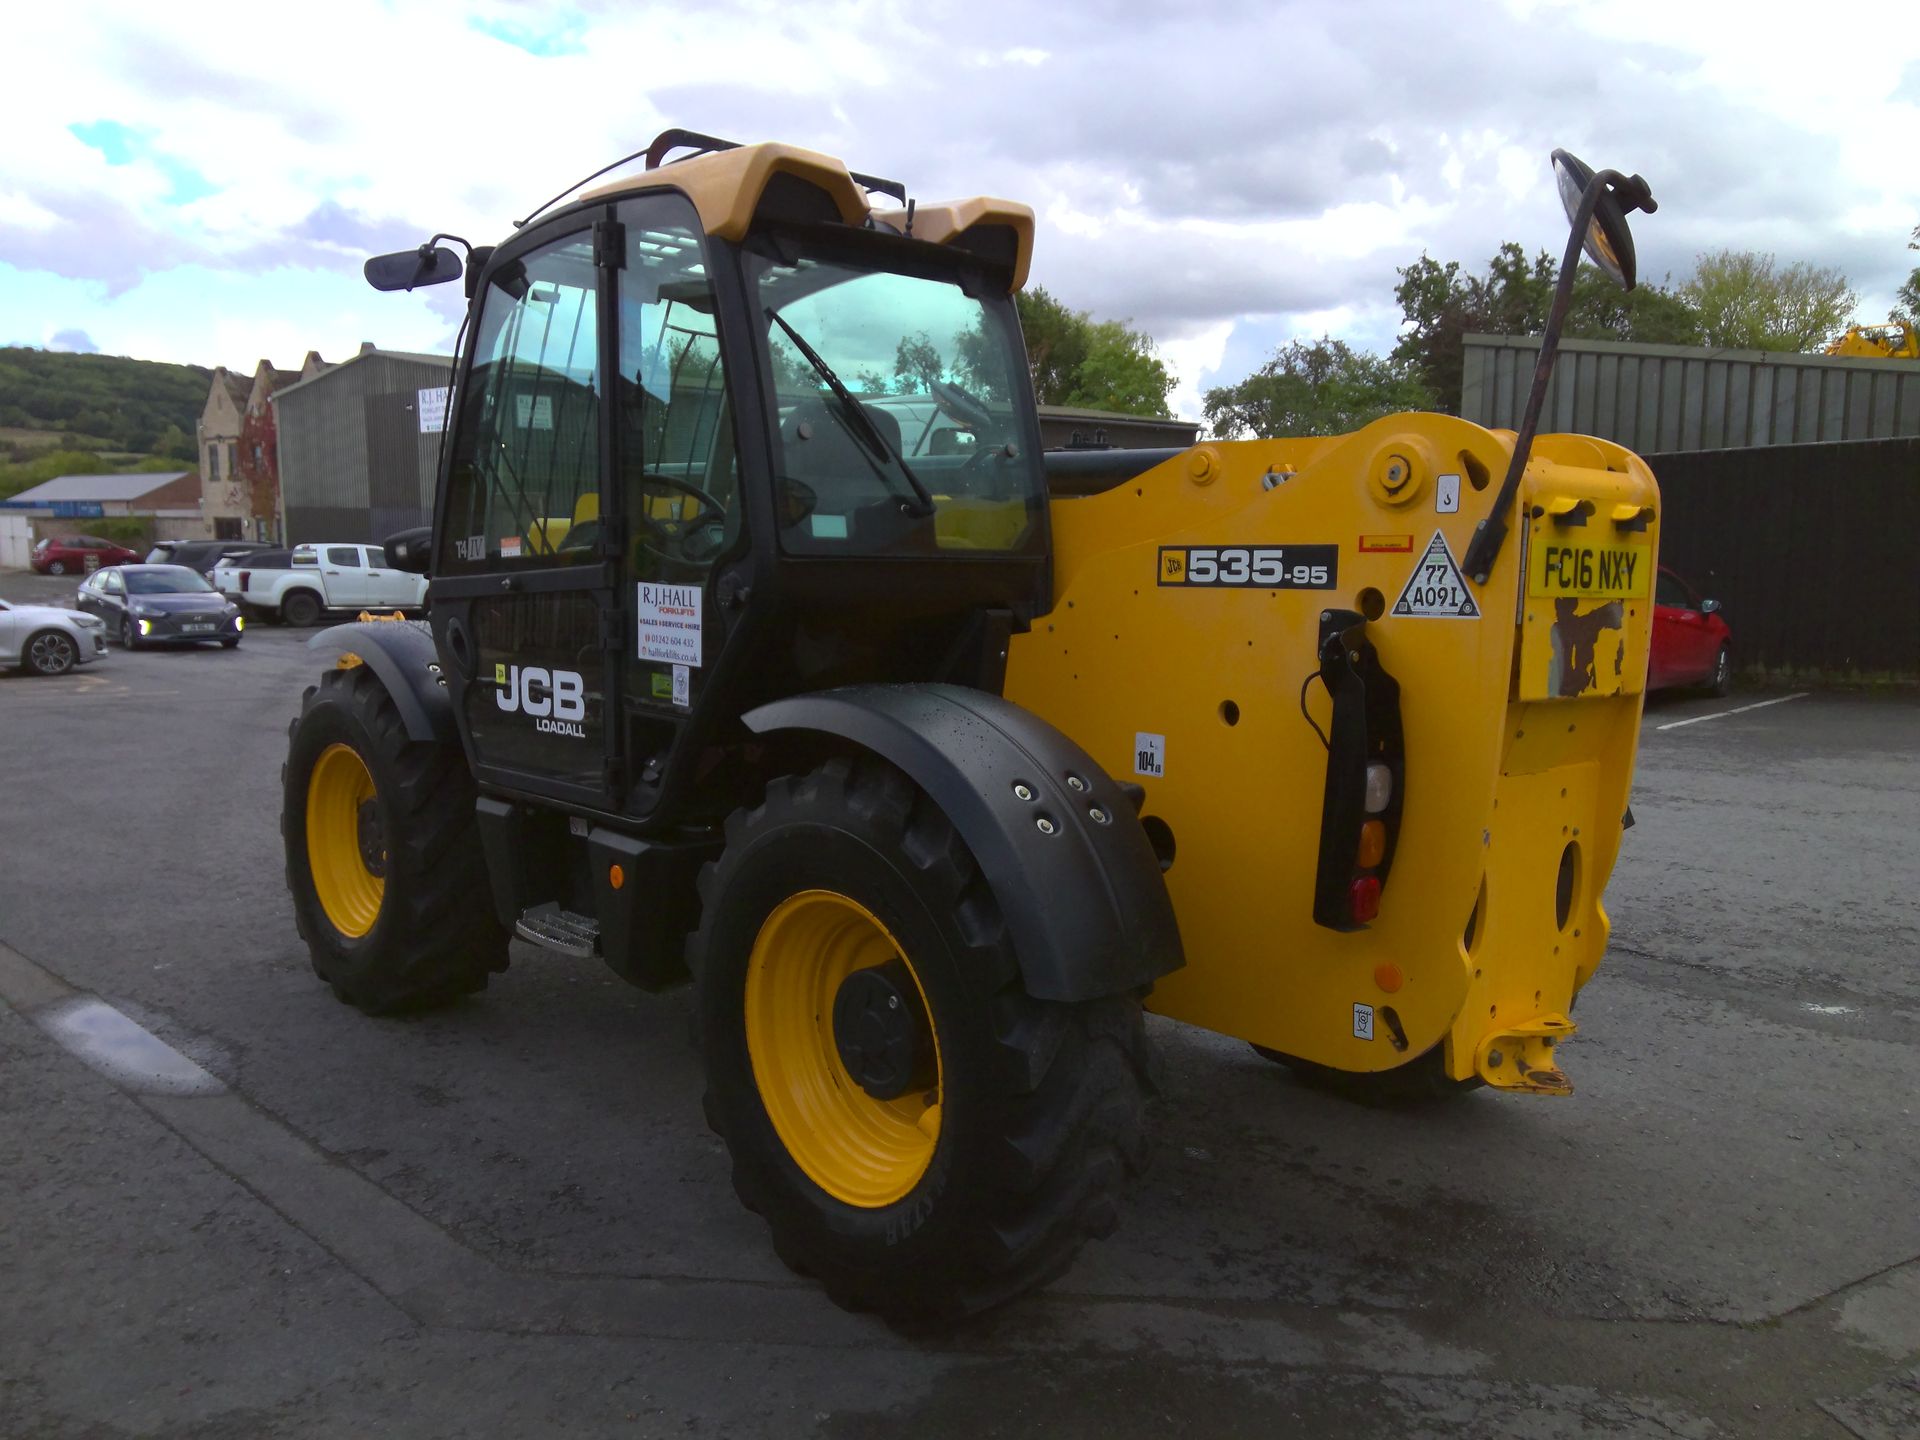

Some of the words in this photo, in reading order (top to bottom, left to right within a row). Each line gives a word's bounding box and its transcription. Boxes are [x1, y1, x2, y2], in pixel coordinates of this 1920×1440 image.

[1167, 558, 1182, 574] JCB
[1188, 549, 1329, 585] 535-95
[1425, 564, 1449, 585] 77
[1544, 547, 1593, 589] FC16
[1599, 551, 1638, 590] NXY
[658, 607, 695, 617] FORKLIFTS
[662, 620, 684, 629] SERVICE
[687, 623, 701, 631] HIRE
[495, 664, 586, 722] JCB
[536, 718, 586, 738] LOADALL
[1138, 750, 1155, 773] 104
